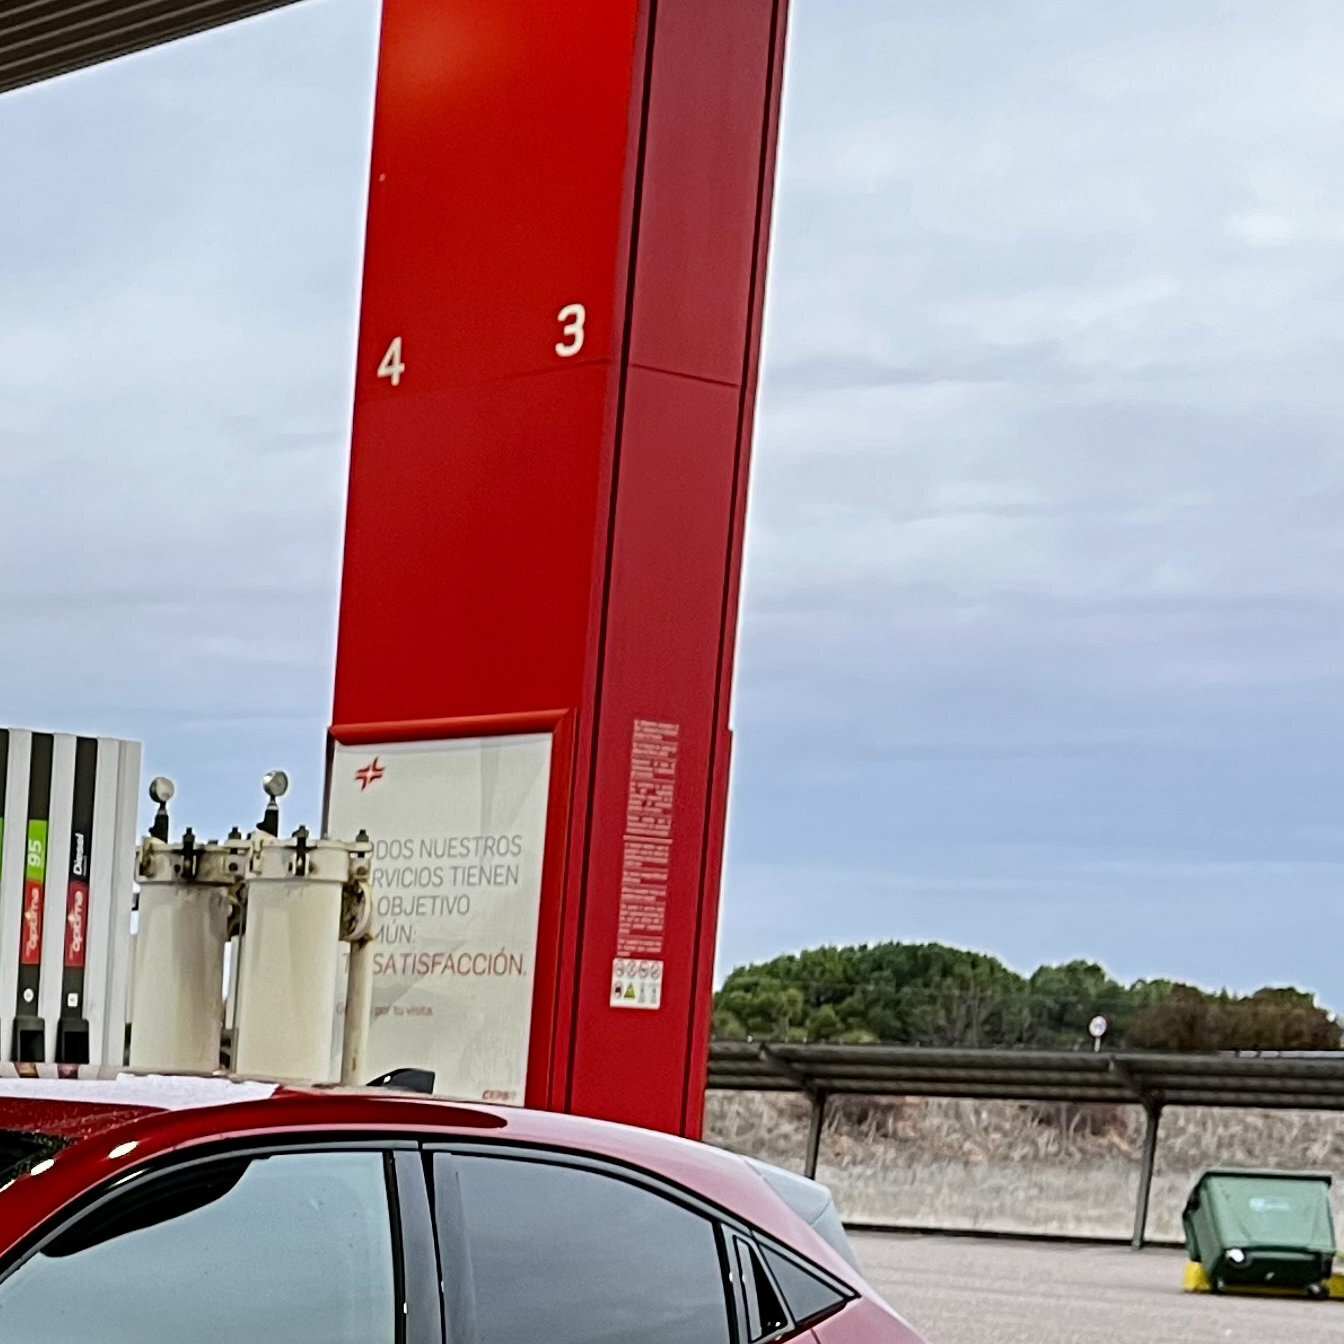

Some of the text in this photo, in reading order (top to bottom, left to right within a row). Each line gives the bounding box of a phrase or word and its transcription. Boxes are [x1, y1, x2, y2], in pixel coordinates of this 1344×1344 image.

[554, 303, 586, 357] 3
[377, 336, 405, 386] 4
[27, 839, 42, 868] 95
[73, 832, 85, 876] Diesel
[371, 834, 522, 861] DOS NUESTROS
[371, 863, 520, 889] RVICIOS TIENEN
[377, 894, 471, 917] OBJETIVO
[373, 946, 527, 977] SATISFACCIÓN.
